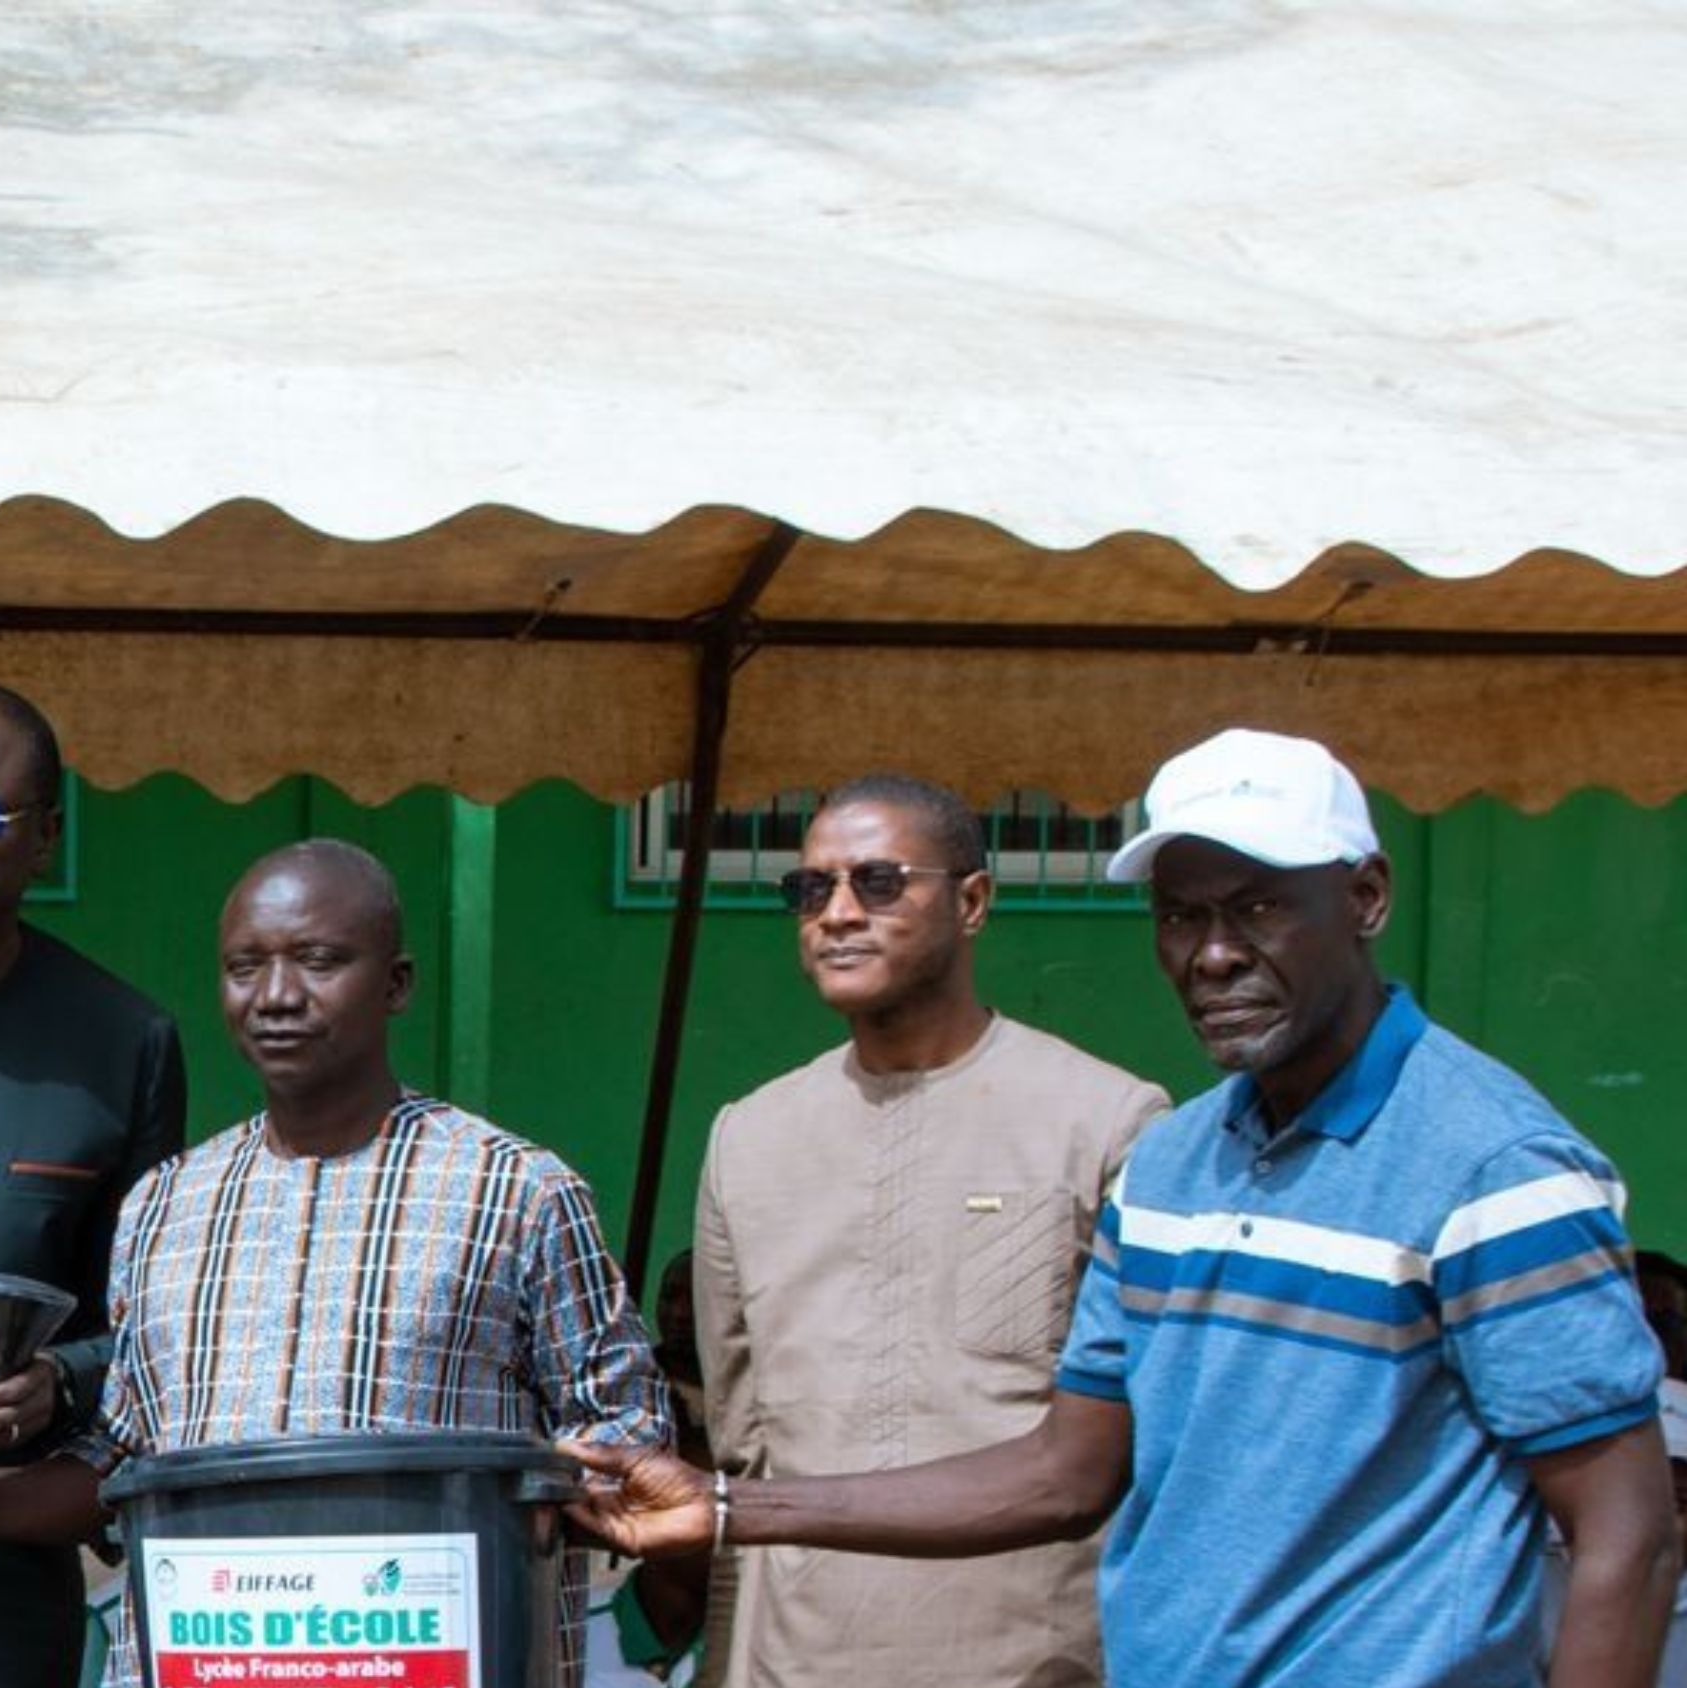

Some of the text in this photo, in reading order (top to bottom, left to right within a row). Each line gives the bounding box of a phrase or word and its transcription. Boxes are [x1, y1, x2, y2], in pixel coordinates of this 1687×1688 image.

[235, 1573, 316, 1593] EIFFAGE
[169, 1603, 441, 1646] BOIS D'ÉCOLE
[249, 1655, 406, 1678] Franco-arabe
